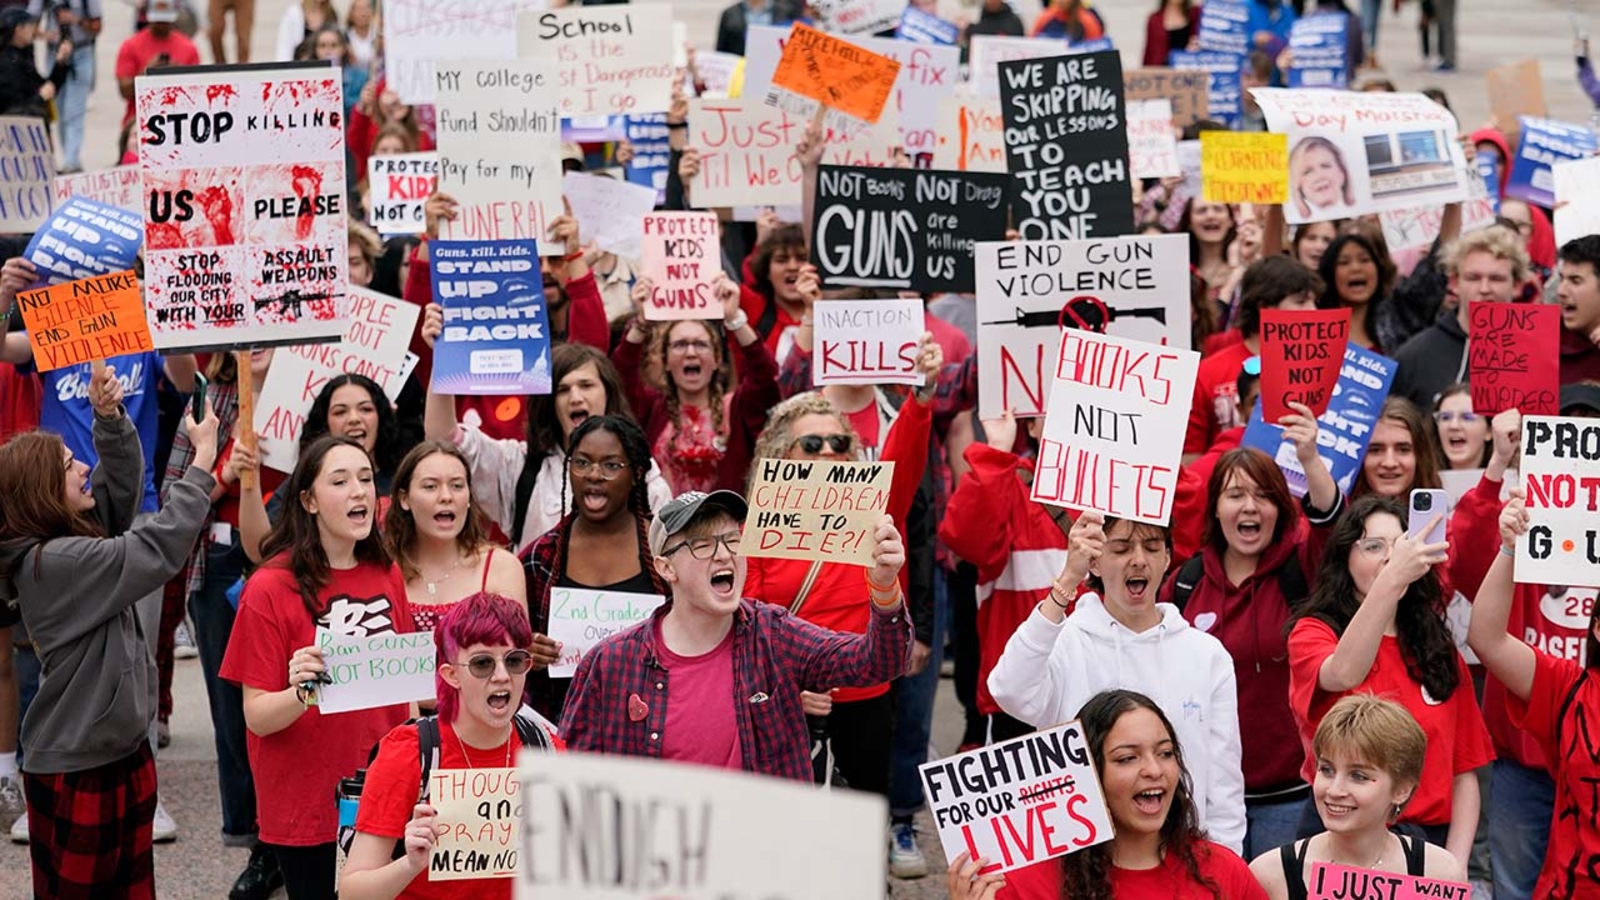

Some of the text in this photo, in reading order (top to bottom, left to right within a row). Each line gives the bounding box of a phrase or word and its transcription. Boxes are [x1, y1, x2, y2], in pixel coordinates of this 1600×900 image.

[539, 13, 633, 39] School
[907, 48, 946, 85] fix
[1005, 58, 1098, 89] WE ARE
[437, 71, 461, 92] MY
[1012, 84, 1117, 123] SKIPPING
[147, 111, 341, 145] STOP KILLING
[440, 108, 478, 132] fund
[701, 108, 797, 149] Just
[1005, 125, 1041, 146] OUR
[1045, 113, 1119, 140] LESSONS
[1291, 110, 1346, 133] Day
[1012, 143, 1064, 169] TO
[441, 157, 535, 189] Pay for my
[744, 153, 781, 186] We
[1015, 159, 1125, 190] TEACH
[820, 170, 866, 201] NOT
[915, 173, 961, 205] NOT
[965, 182, 1001, 209] Drag
[1020, 187, 1091, 217] YOU
[150, 189, 340, 223] US PLEASE
[375, 203, 407, 221] NOT
[52, 216, 101, 245] UP
[64, 206, 139, 241] STAND
[643, 216, 716, 235] PROTECT
[927, 212, 958, 229] are
[1018, 213, 1098, 239] ONE
[436, 245, 531, 258] Guns. Kill. Kids.
[664, 237, 705, 259] KIDS
[816, 204, 918, 279] GUNS
[178, 253, 220, 271] STOP
[264, 248, 334, 266] ASSAULT
[436, 260, 532, 274] STAND
[997, 242, 1154, 271] END GUN
[167, 272, 232, 288] FLOODING
[262, 266, 337, 284] WEAPONS
[667, 263, 699, 280] NOT
[996, 268, 1157, 298] VIOLENCE
[20, 290, 51, 312] NO
[171, 288, 230, 304] OUR CITY
[439, 280, 498, 298] UP
[652, 283, 709, 309] GUNS
[35, 292, 120, 329] SILENCE
[157, 304, 244, 323] WITH YOUR
[442, 304, 541, 321] FIGHT
[821, 308, 912, 329] INACTION
[1472, 305, 1539, 331] GUNS
[35, 312, 117, 347] END GUN
[444, 323, 543, 342] BACK
[1263, 320, 1347, 342] PROTECT
[1472, 331, 1516, 347] ARE
[44, 330, 149, 368] VIOLENCE
[822, 340, 917, 374] KILLS
[1284, 342, 1331, 361] KIDS.
[1472, 348, 1530, 368] MADE
[1057, 332, 1178, 405] BOOKS
[1289, 366, 1325, 385] NOT
[1340, 366, 1384, 391] AND
[1470, 370, 1499, 384] TO
[56, 362, 144, 402] Baall
[1282, 388, 1325, 410] GUNS
[1474, 386, 1555, 412] MURDER
[1074, 404, 1142, 445] NOT
[1524, 421, 1600, 460] PRO
[764, 460, 882, 484] HOW MANY
[1033, 438, 1172, 520] BULLETS
[756, 485, 890, 511] CHILDREN
[1525, 473, 1600, 511] NOT
[757, 512, 847, 530] HAVE TO
[554, 590, 588, 620] 2nd
[1564, 597, 1594, 617] 28
[331, 663, 361, 685] NOT
[924, 728, 1090, 803] FIGHTING
[936, 775, 1076, 829] FOR OUR RIGHTS
[961, 794, 1097, 877] LIVES
[432, 849, 490, 872] MEAN
[1316, 867, 1468, 900] I JUST WANT
